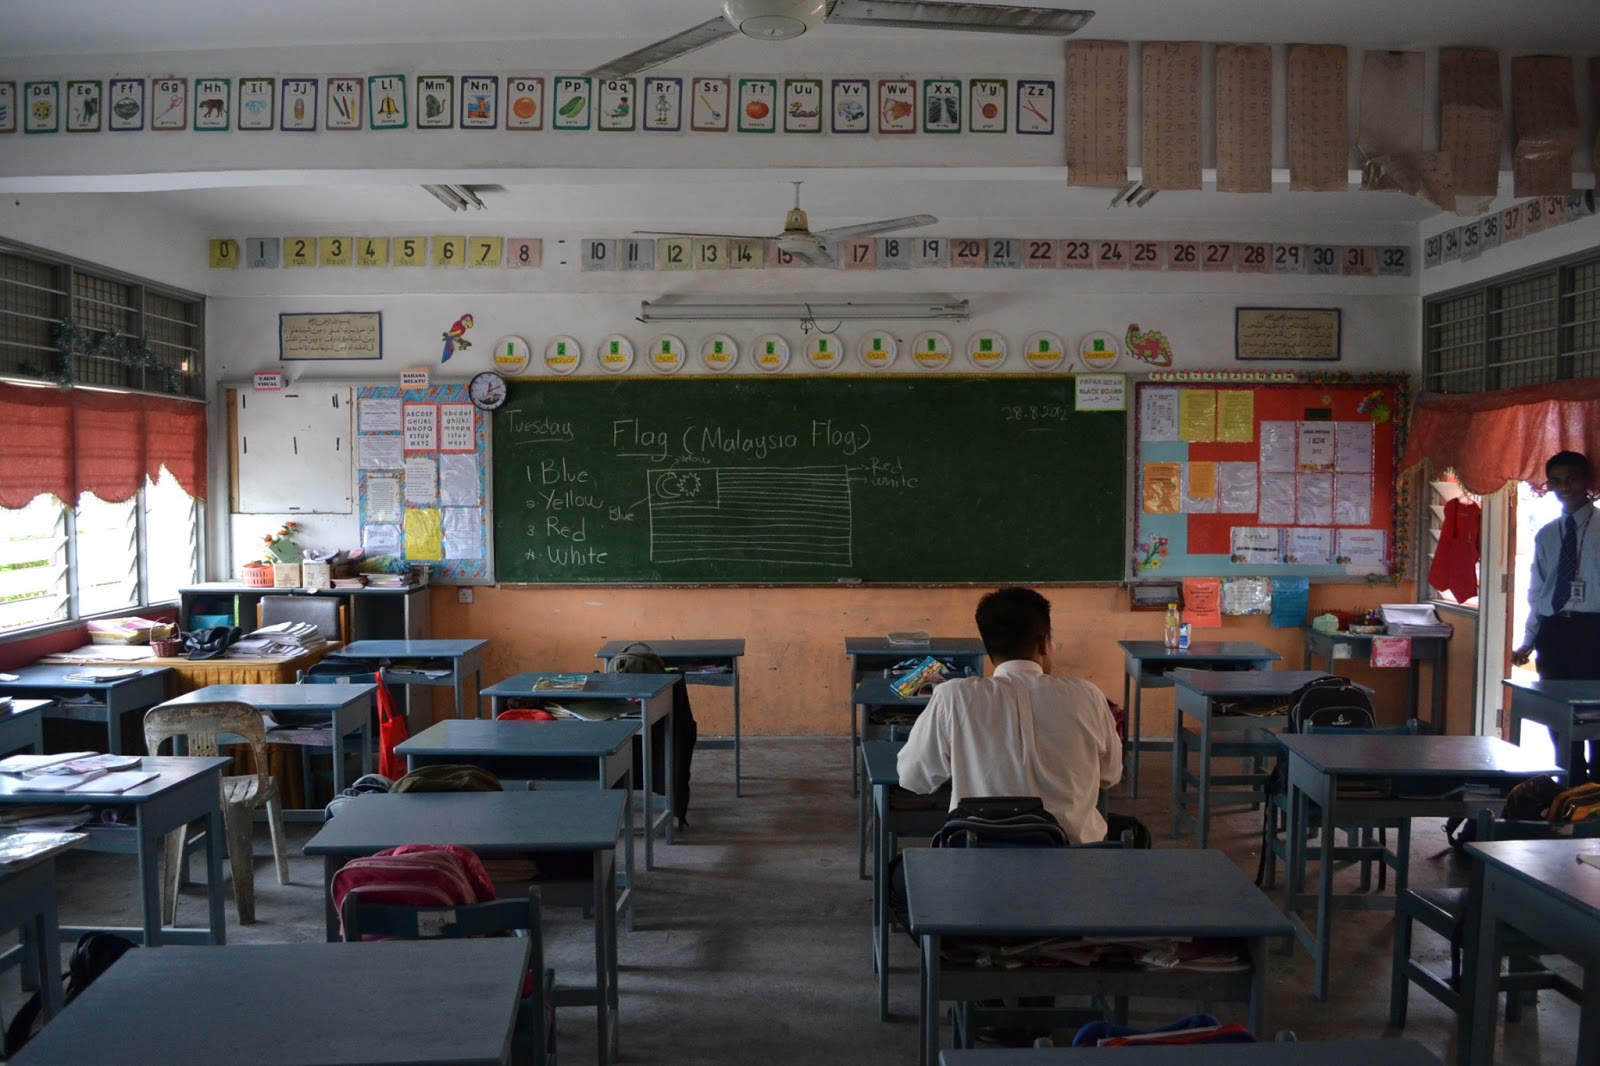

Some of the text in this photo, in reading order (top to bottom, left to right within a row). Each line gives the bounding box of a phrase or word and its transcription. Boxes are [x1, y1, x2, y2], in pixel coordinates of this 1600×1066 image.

[1505, 210, 1519, 230] 37
[1527, 200, 1540, 223] 38
[1484, 217, 1497, 237] 36
[1446, 233, 1457, 251] 34
[1464, 226, 1478, 246] 35
[220, 241, 229, 258] 0
[295, 240, 305, 257] 2
[331, 240, 342, 256] 3
[365, 241, 375, 257] 4
[404, 240, 415, 257] 5
[443, 242, 454, 259] 6
[480, 244, 491, 261] 7
[519, 244, 530, 261] 8
[591, 242, 606, 259] 10
[629, 243, 638, 261] 11
[668, 245, 683, 263] 12
[702, 245, 717, 261] 13
[738, 245, 752, 262] 14
[777, 247, 793, 264] 15
[853, 245, 869, 262] 17
[885, 239, 899, 257] 18
[923, 239, 939, 257] 19
[958, 240, 980, 257] 20
[993, 240, 1010, 258] 21
[1030, 242, 1051, 259] 22
[1066, 242, 1089, 259] 23
[1101, 242, 1122, 260] 24
[1135, 243, 1157, 261] 25
[1174, 244, 1195, 262] 26
[1207, 244, 1230, 262] 27
[1244, 245, 1265, 264] 28
[1275, 246, 1299, 264] 29
[1427, 238, 1438, 257] 33
[1313, 248, 1334, 266] 30
[1348, 248, 1364, 265] 31
[1384, 249, 1405, 266] 32
[558, 344, 565, 355] 2
[611, 343, 618, 353] 3
[662, 342, 669, 353] 4
[716, 342, 722, 353] 5
[767, 342, 774, 354] 6
[820, 341, 826, 351] 7
[873, 339, 880, 350] 8
[928, 340, 934, 351] 9
[981, 340, 992, 351] 10
[1040, 340, 1049, 351] 11
[1094, 340, 1104, 351] 12
[505, 410, 574, 441] Tuesday
[613, 418, 668, 462] Flag
[541, 457, 589, 486] Blue
[871, 456, 903, 477] Red
[538, 488, 604, 511] Yellow
[608, 504, 635, 521] Blue
[546, 515, 586, 542] Red
[547, 545, 608, 566] White
